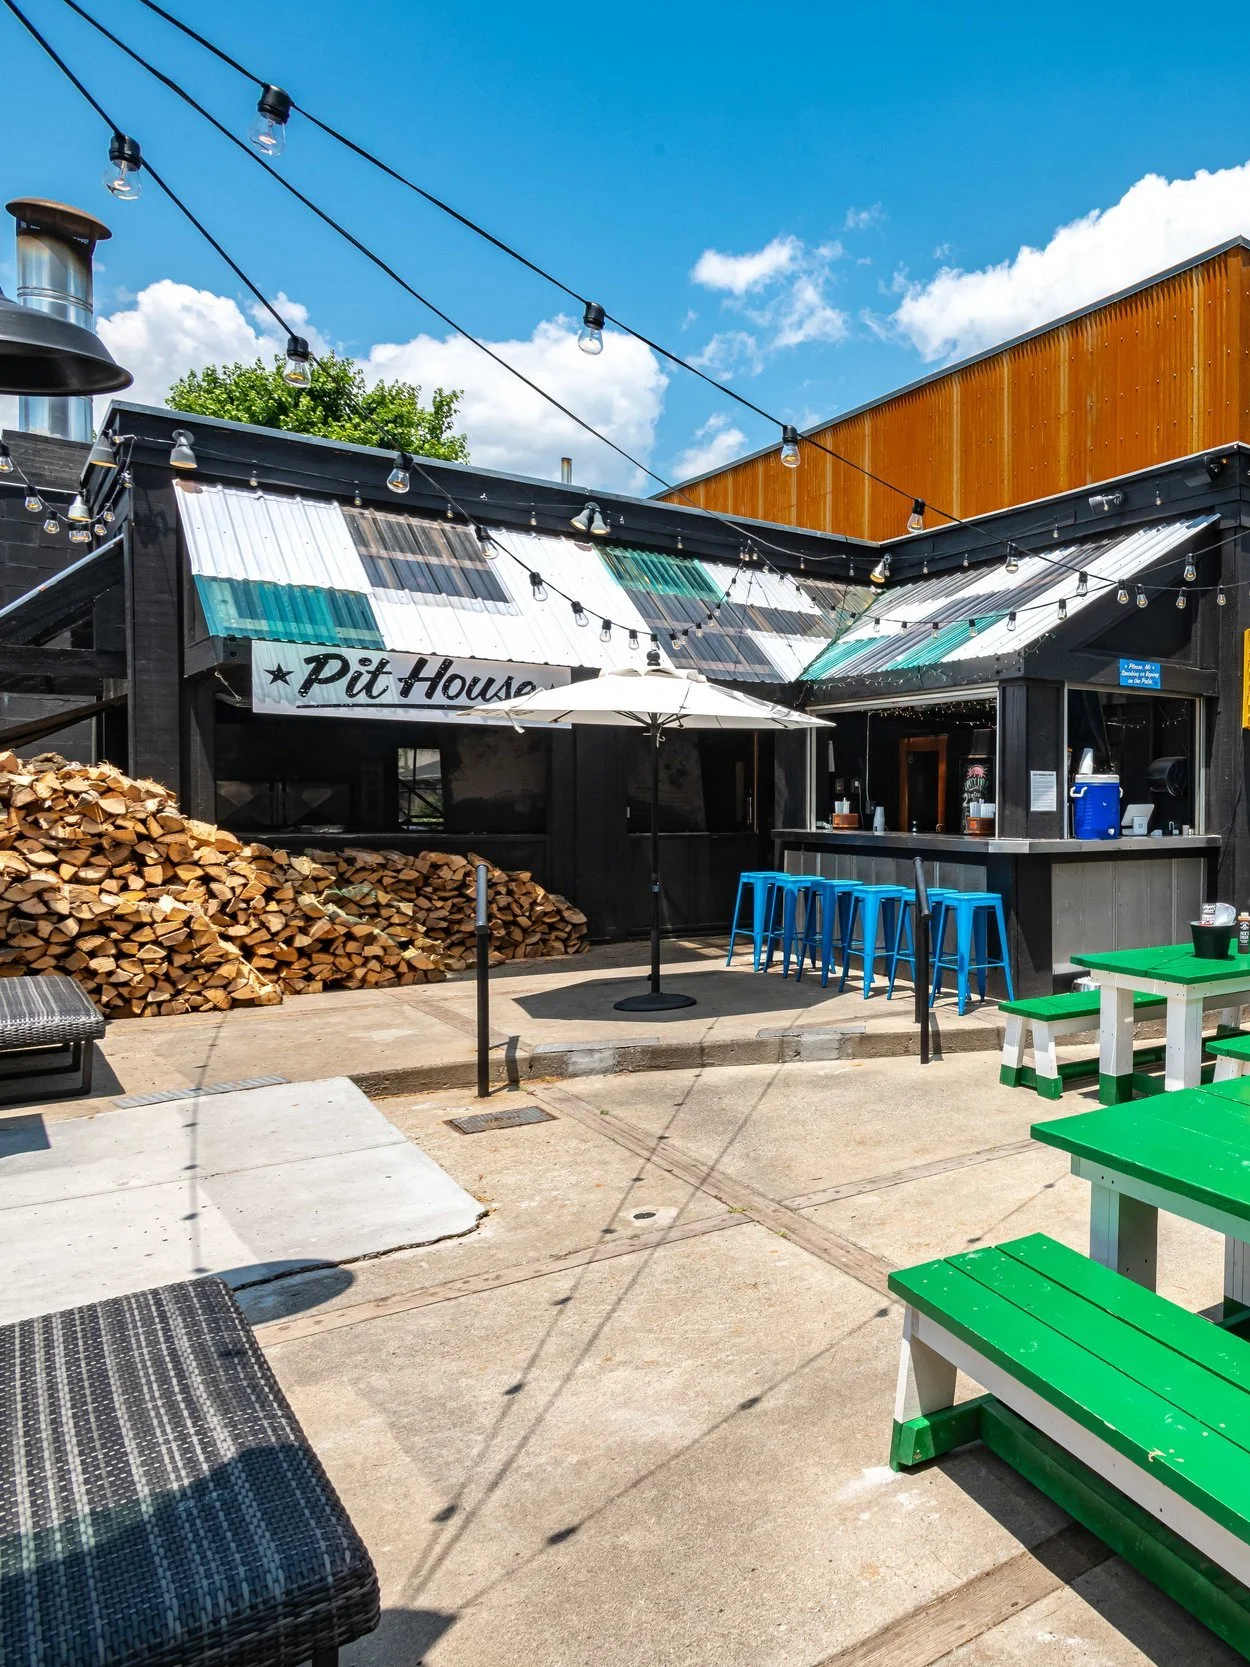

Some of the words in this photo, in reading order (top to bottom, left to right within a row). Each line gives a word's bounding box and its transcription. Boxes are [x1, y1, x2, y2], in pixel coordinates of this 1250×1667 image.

[297, 652, 393, 699] Pit
[397, 656, 537, 703] House
[1121, 669, 1139, 677] Smoking
